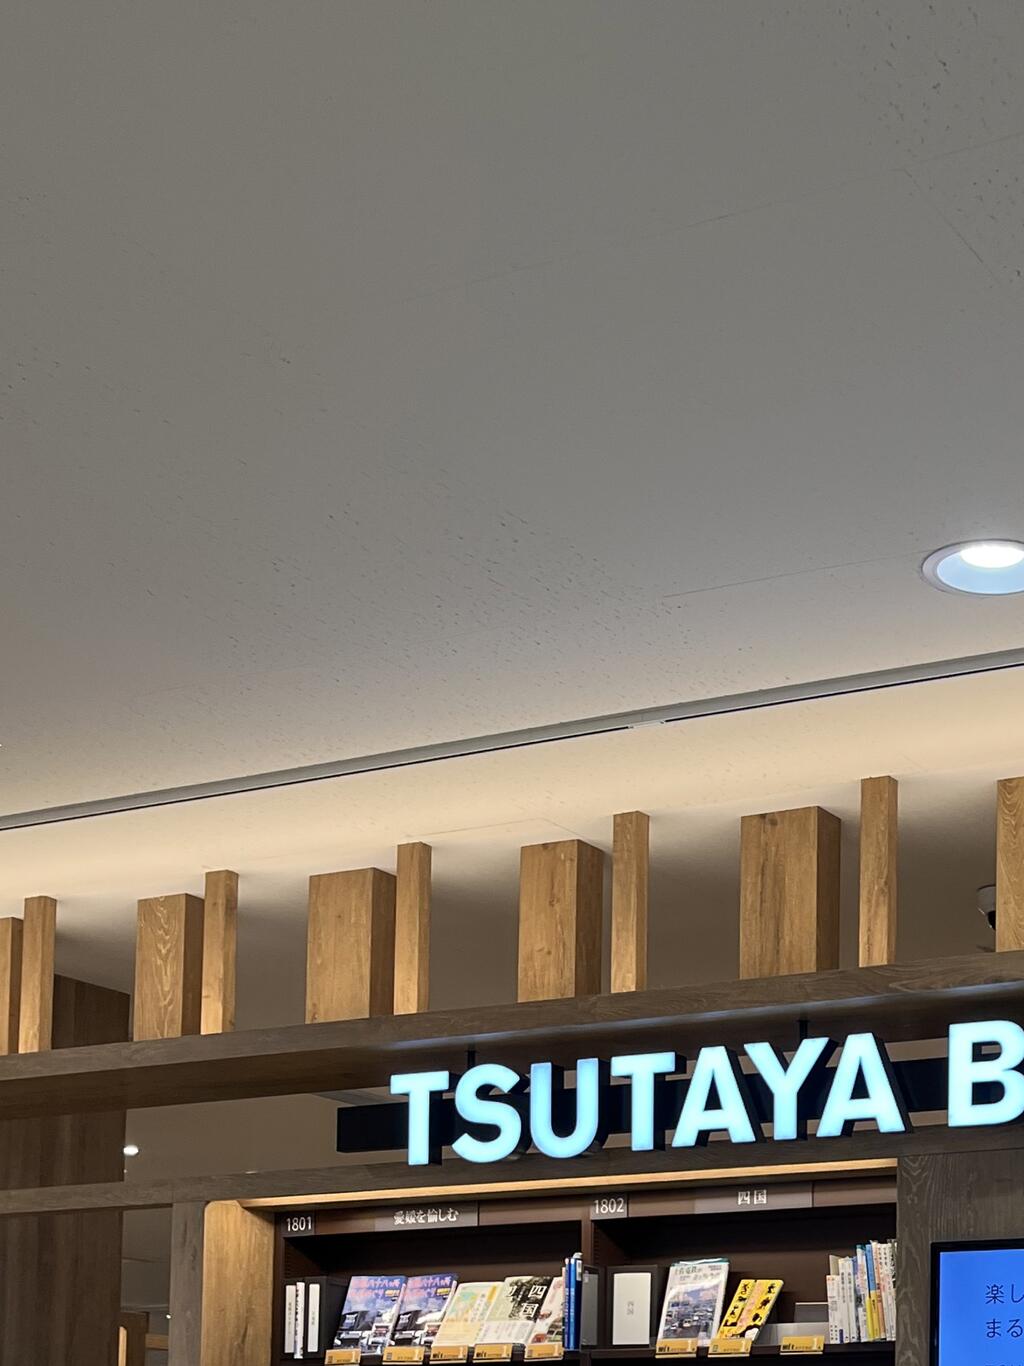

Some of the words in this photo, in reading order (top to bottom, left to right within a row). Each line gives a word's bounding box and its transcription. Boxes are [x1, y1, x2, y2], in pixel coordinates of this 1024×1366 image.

[390, 1032, 906, 1166] TSUTAYA
[594, 1197, 624, 1214] 1802
[737, 1189, 767, 1205] 四国
[286, 1216, 312, 1232] 1801
[393, 1207, 459, 1226] 愛媛を愉しむ
